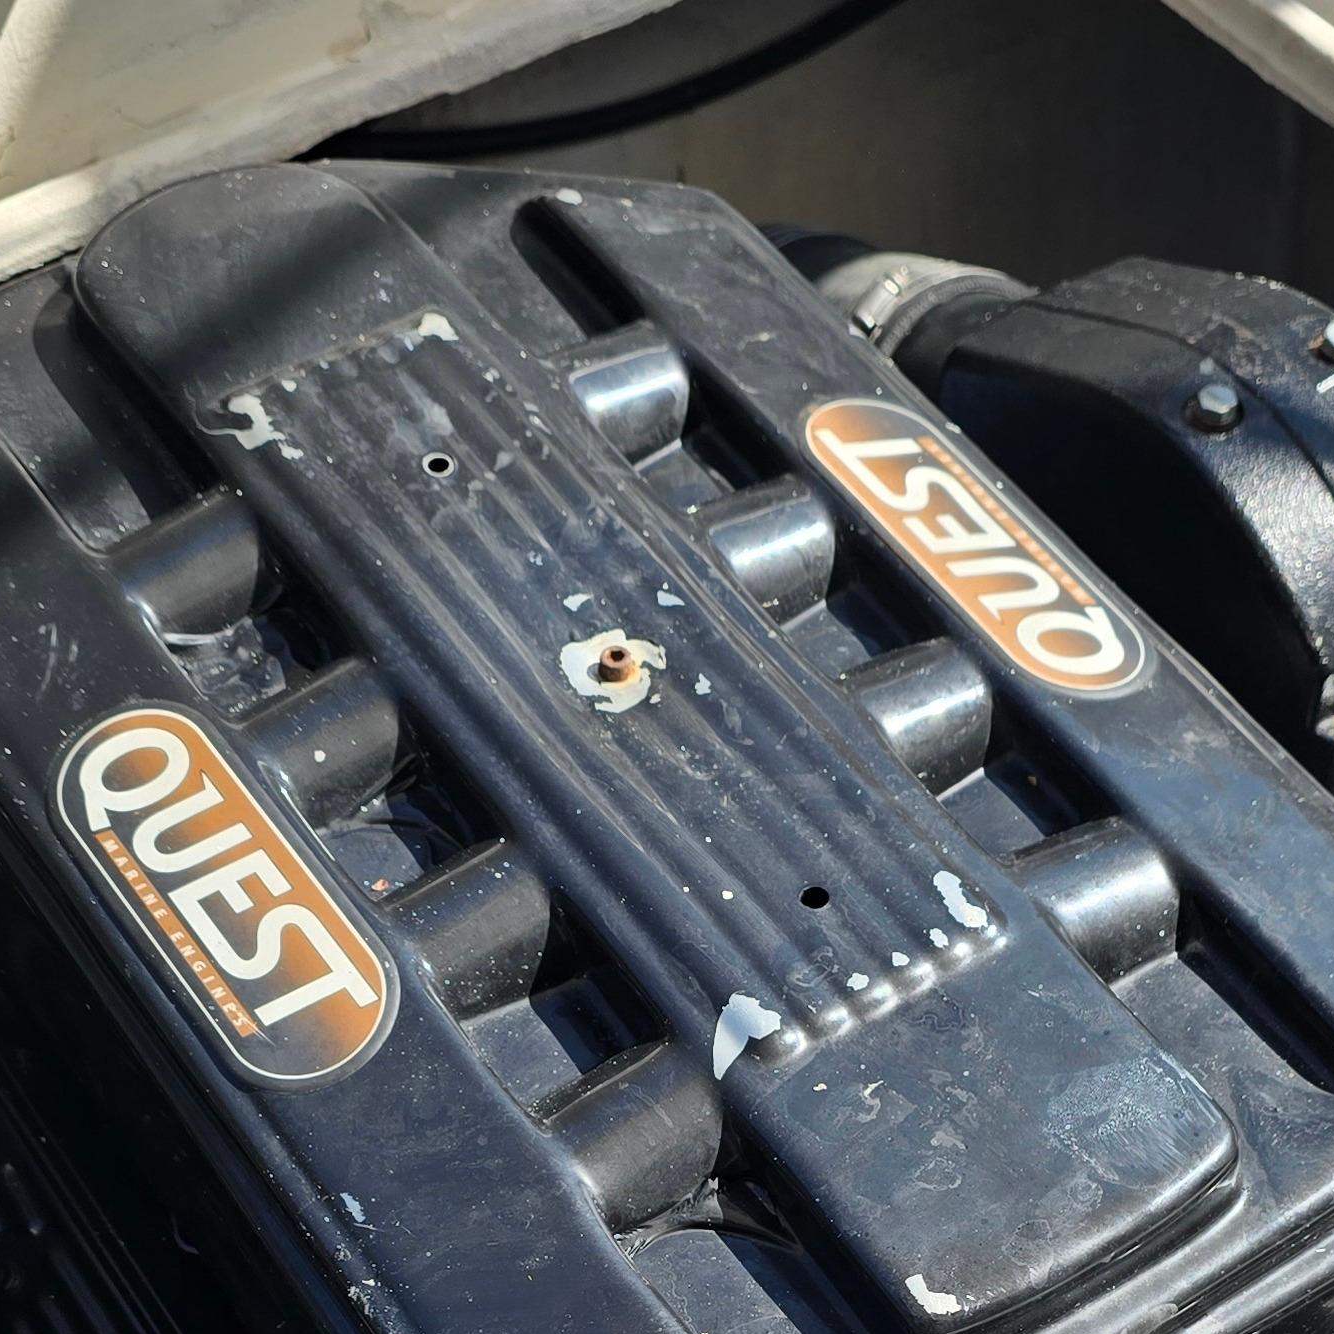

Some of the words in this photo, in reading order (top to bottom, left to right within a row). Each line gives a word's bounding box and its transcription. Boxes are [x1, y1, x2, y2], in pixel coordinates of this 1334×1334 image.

[814, 428, 1125, 675] QUEST
[79, 727, 380, 1027] QUEST
[102, 839, 168, 920] MARINE
[170, 930, 247, 1028] ENGINES
